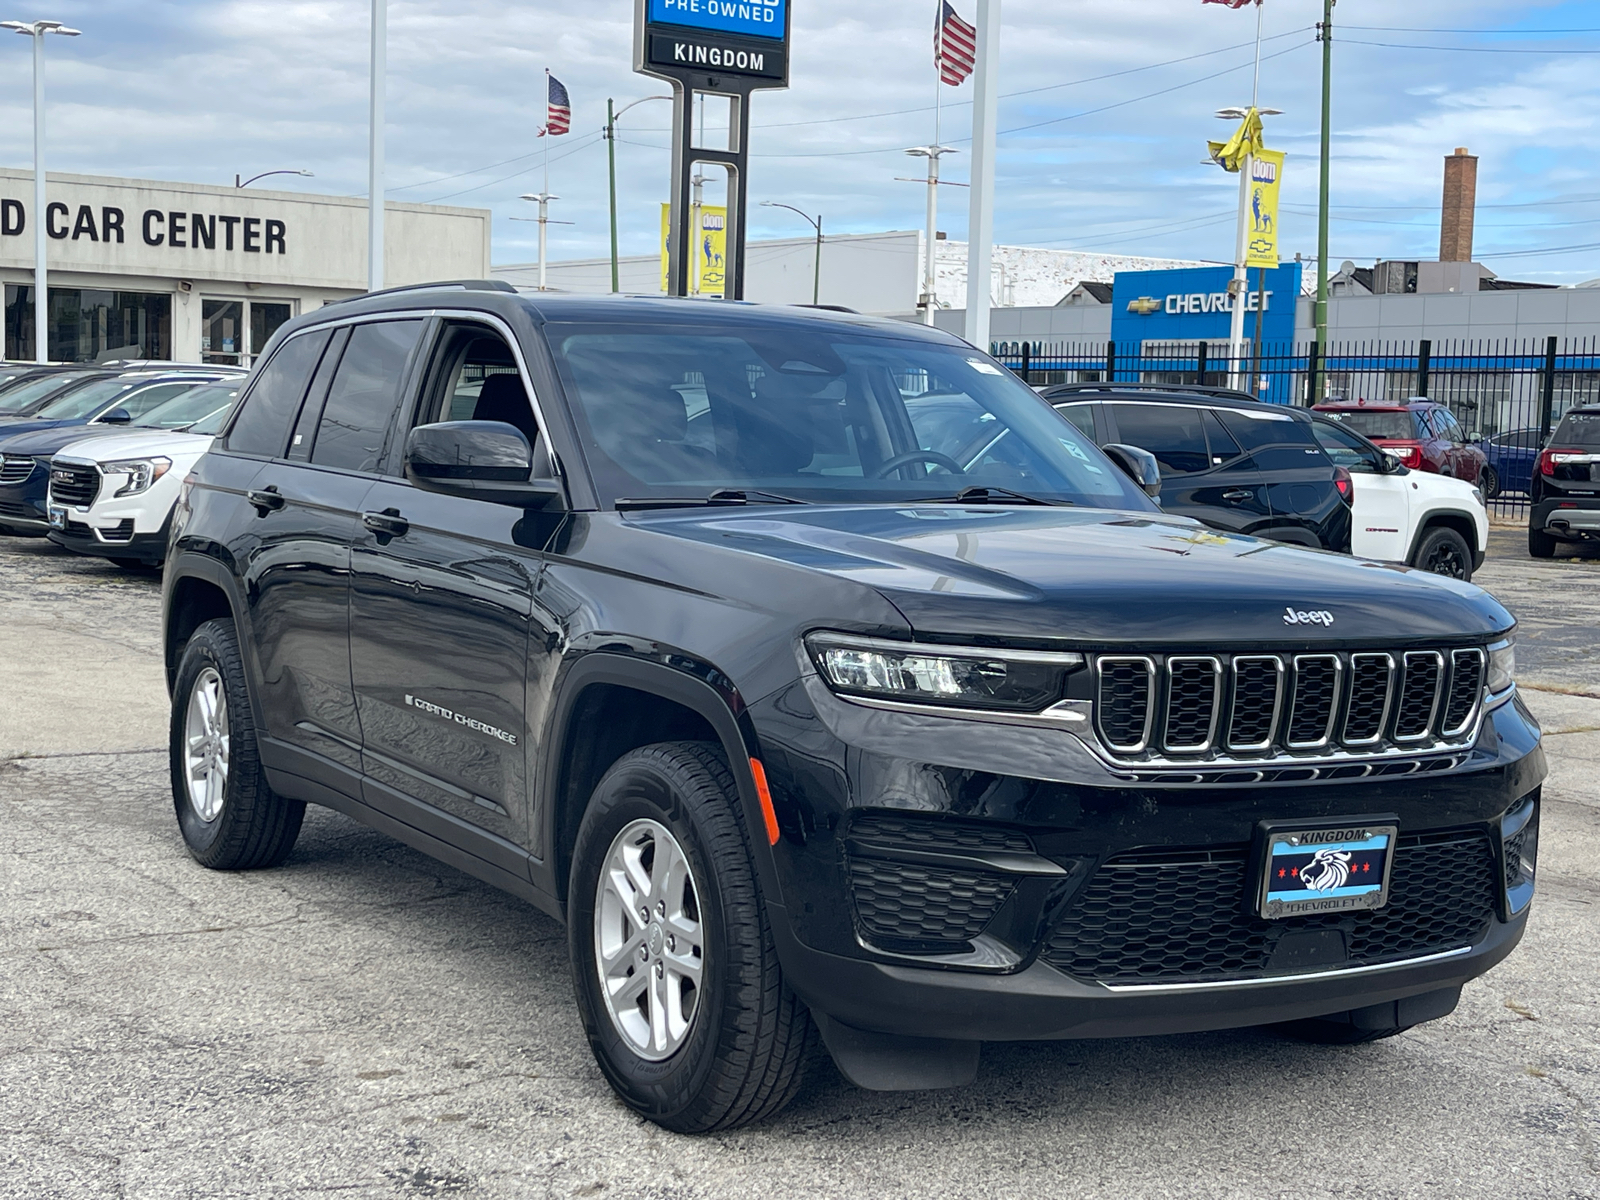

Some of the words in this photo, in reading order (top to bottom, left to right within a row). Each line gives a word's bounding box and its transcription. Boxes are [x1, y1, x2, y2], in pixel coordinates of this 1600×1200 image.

[665, 0, 774, 23] PRE-OWNED
[674, 43, 764, 71] KINGDOM
[46, 202, 124, 243] CAR
[142, 209, 286, 254] CENTER
[1283, 606, 1334, 627] Jeep
[414, 699, 453, 719] GRAND
[454, 713, 517, 745] CHEROKEE
[1300, 829, 1366, 844] KINGDOM
[1290, 898, 1357, 913] CHEVROLET
